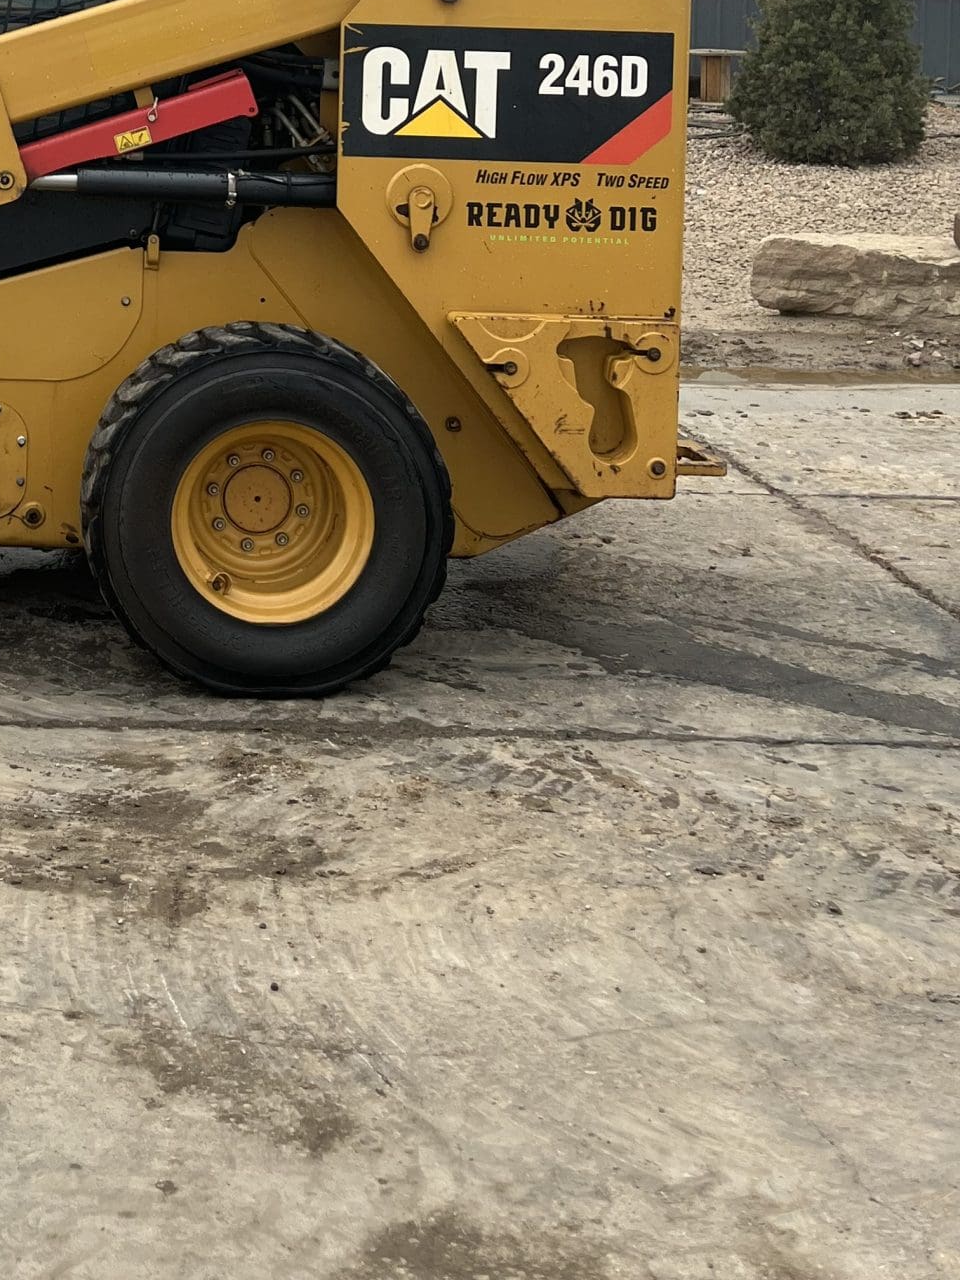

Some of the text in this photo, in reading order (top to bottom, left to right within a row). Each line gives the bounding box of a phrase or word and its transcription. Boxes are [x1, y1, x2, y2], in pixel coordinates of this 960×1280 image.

[361, 46, 648, 139] CAT 246D
[550, 172, 581, 187] XPS
[466, 202, 657, 232] READY DIG
[489, 234, 630, 246] UNLIMITED POTENTIAL
